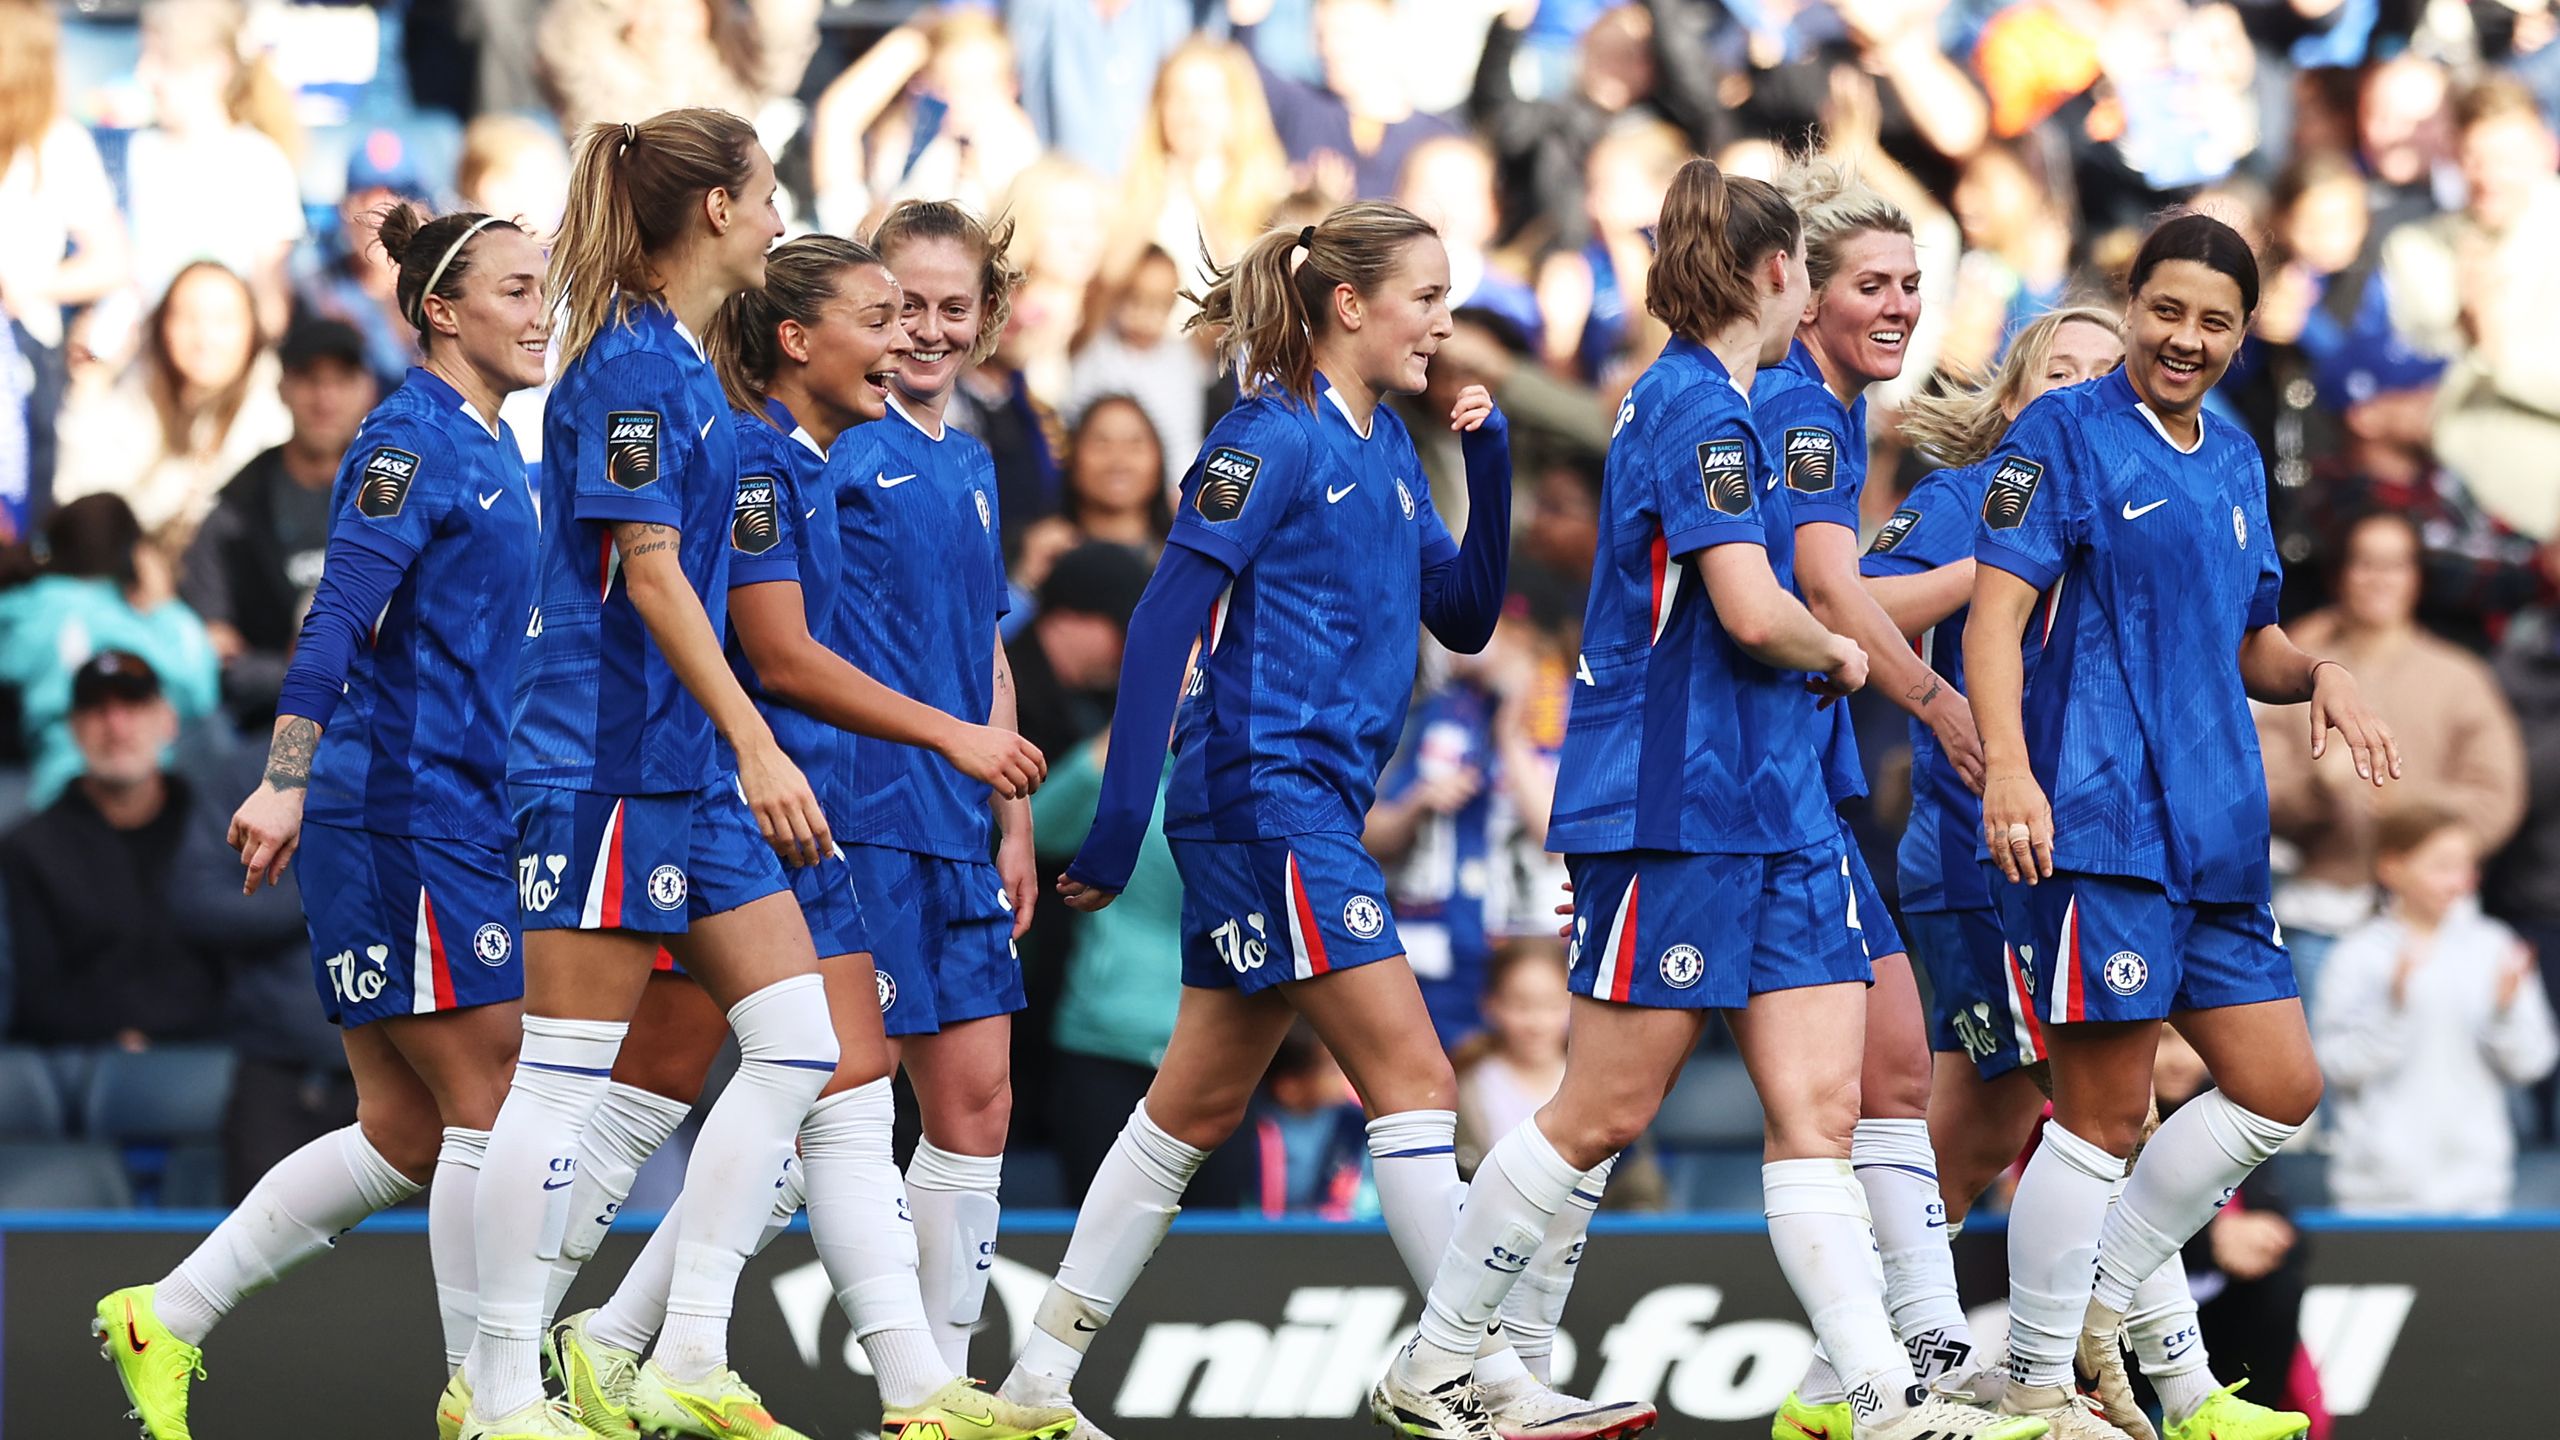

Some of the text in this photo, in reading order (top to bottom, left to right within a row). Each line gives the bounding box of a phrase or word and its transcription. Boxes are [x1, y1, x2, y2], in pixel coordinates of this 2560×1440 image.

[610, 424, 654, 439] WSL
[1788, 437, 1832, 451] WSL
[370, 456, 412, 477] WSL
[388, 452, 414, 465] BARCLAYS
[1229, 454, 1255, 467] BARCLAYS
[1704, 452, 1744, 469] WSL
[1209, 457, 1253, 480] WSL
[2013, 462, 2036, 474] BARCLAYS
[1996, 466, 2034, 488] WSL
[1668, 945, 1698, 957] CHELSEA
[2111, 952, 2140, 964] CHELSEA
[326, 950, 387, 1004] Flo
[1492, 1246, 1531, 1267] CFC
[2163, 1325, 2197, 1348] CFC
